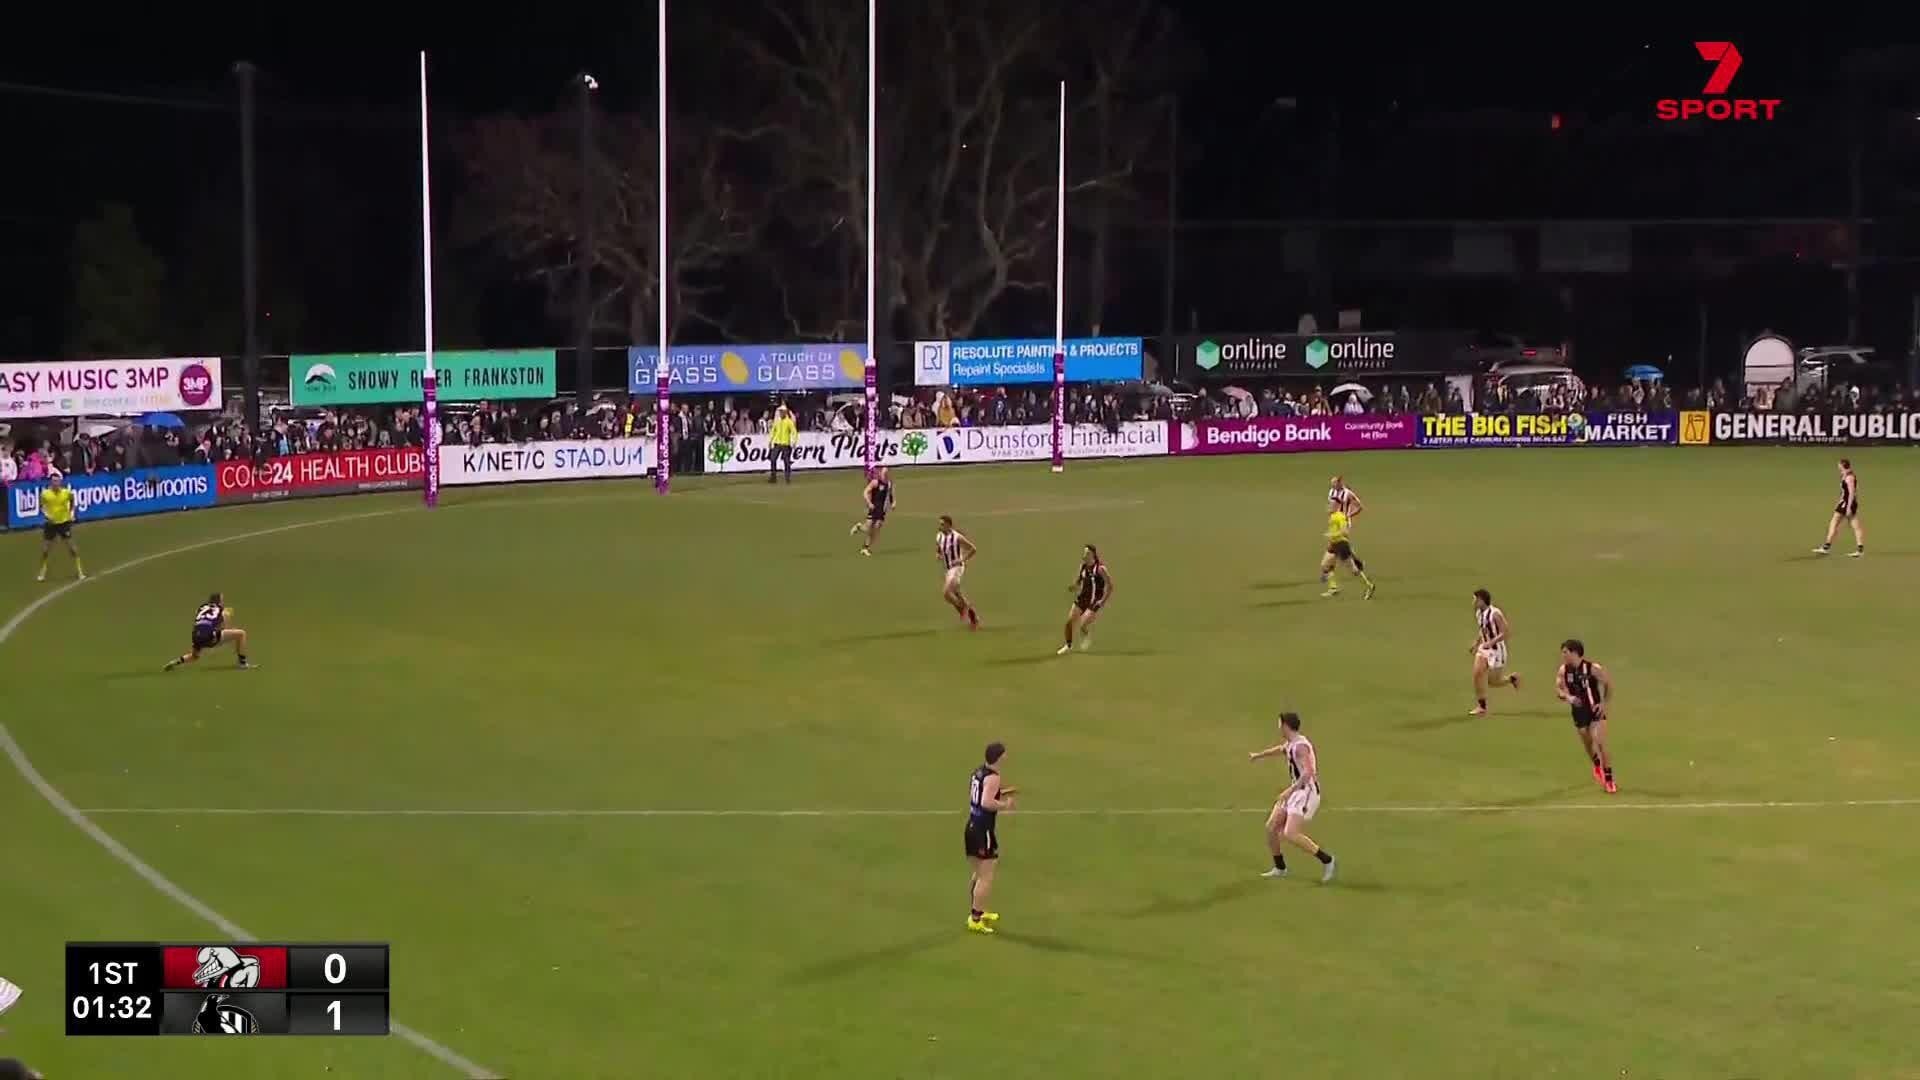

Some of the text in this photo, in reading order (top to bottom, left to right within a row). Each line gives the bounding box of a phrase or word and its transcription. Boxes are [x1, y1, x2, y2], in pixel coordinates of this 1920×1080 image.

[759, 354, 767, 363] A
[770, 352, 813, 363] TOUCH
[953, 342, 1139, 361] RESOLUTE PAINTIG & PROJECTS
[1222, 338, 1286, 360] online
[1330, 337, 1394, 359] online
[635, 355, 644, 366] A
[953, 363, 991, 377] Repaint
[993, 361, 1046, 376] Specialists
[0, 366, 169, 393] ASY MUSIC 3MP
[348, 367, 544, 390] SNOWY RIER FRANKSTON
[757, 365, 835, 382] GLASS
[183, 377, 209, 391] 3MP
[1423, 413, 1568, 437] THE BIG FISH
[1607, 413, 1649, 425] FISH
[1715, 412, 1920, 440] GENERAL PUBLIC
[1070, 424, 1161, 446] Financial
[1207, 422, 1331, 447] Bendigo Bank
[1583, 424, 1672, 441] MARKET
[301, 457, 369, 482] HEALTH
[195, 604, 220, 621] 23
